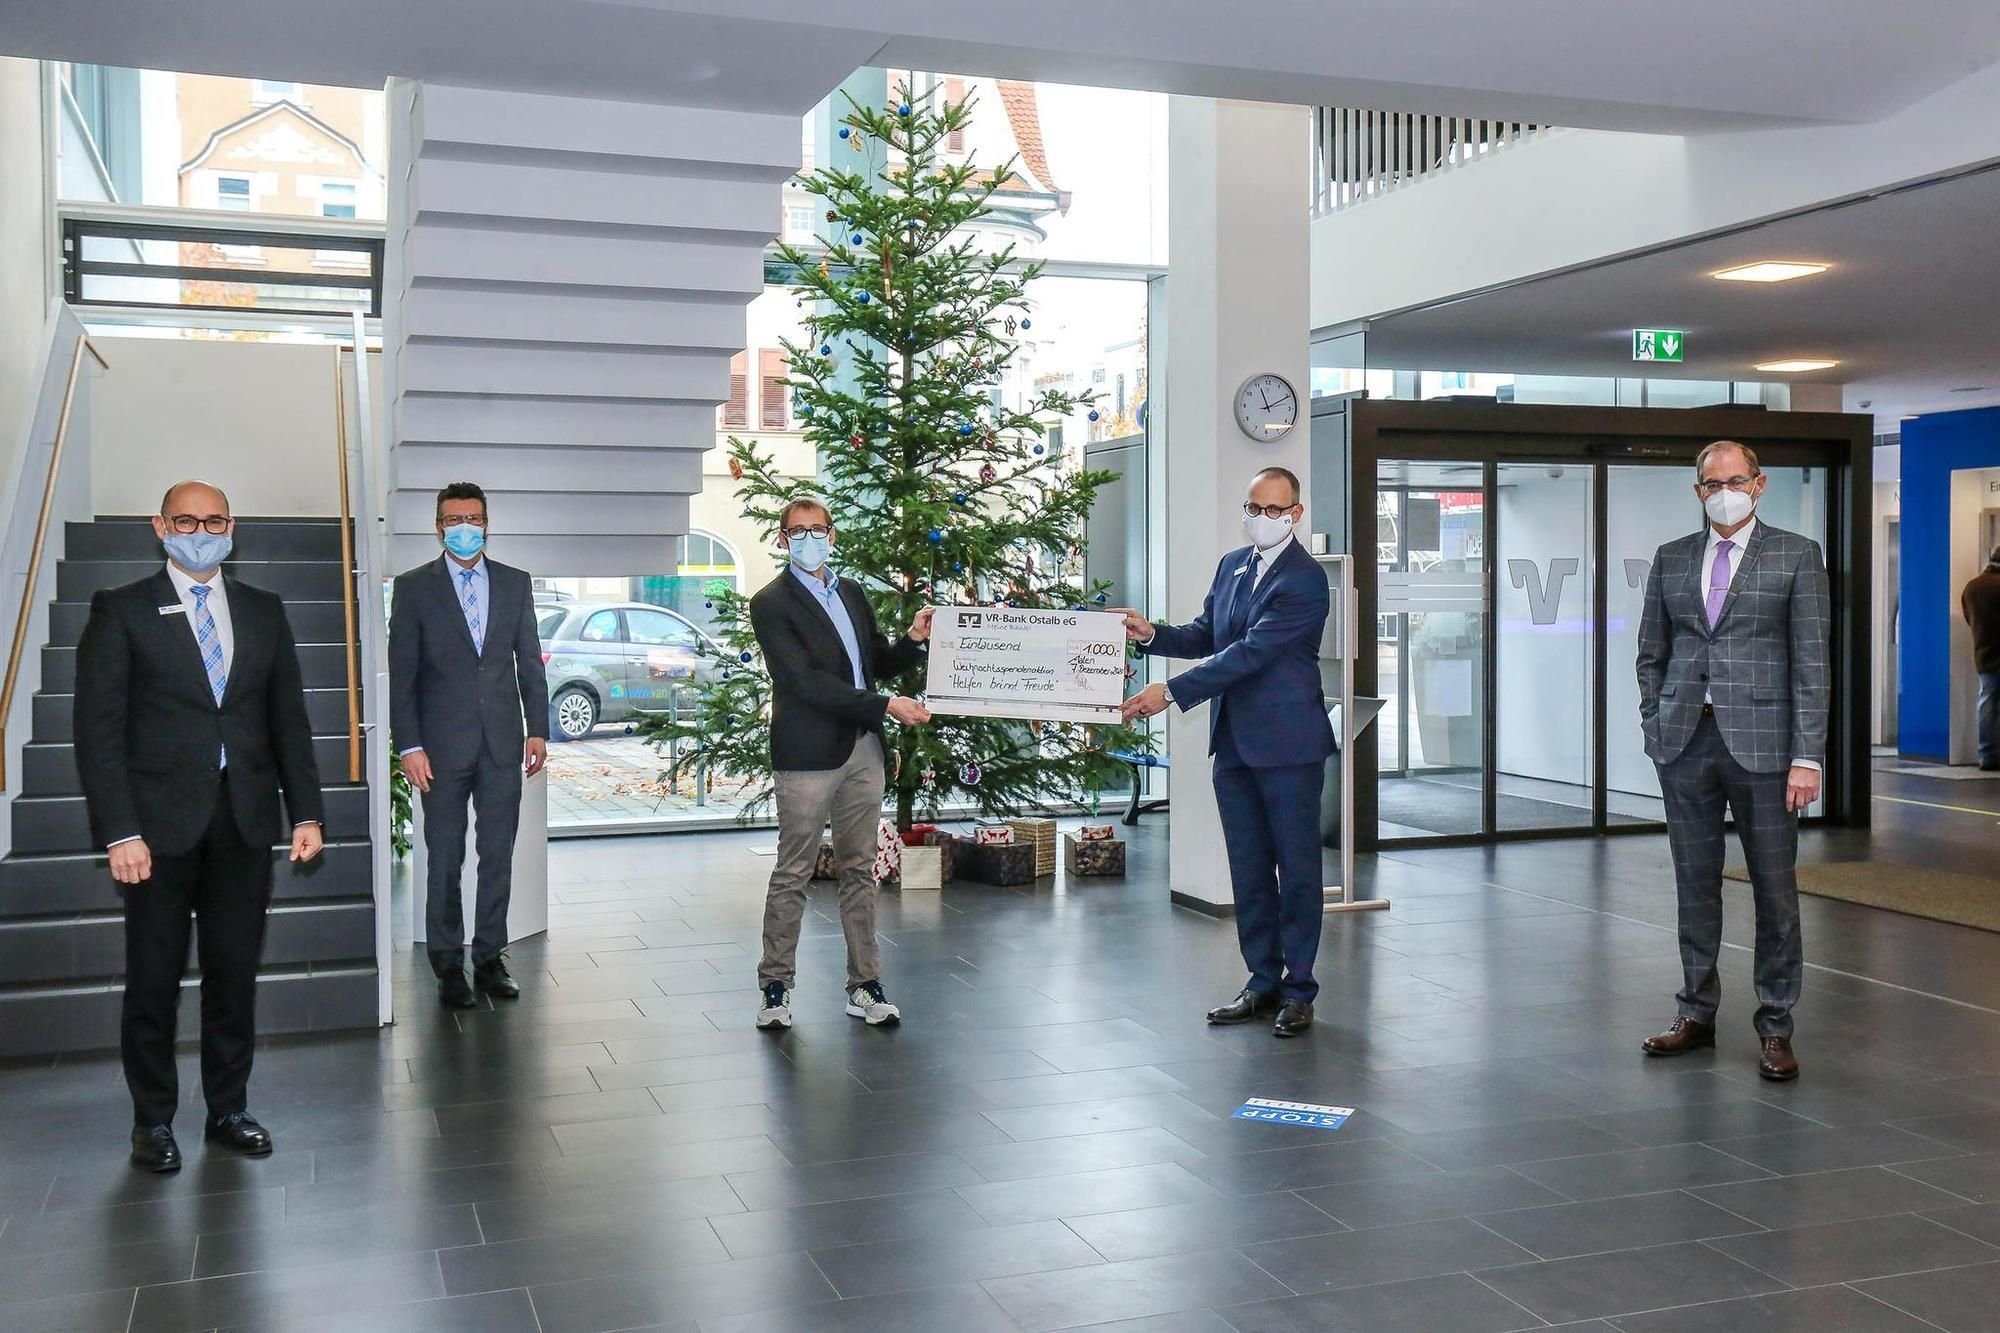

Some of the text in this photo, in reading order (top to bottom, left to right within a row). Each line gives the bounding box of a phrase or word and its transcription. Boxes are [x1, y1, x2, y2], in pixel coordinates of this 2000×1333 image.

[986, 613, 1077, 626] VR-Bank Ostalb eG
[1241, 1109, 1338, 1126] STOPP
